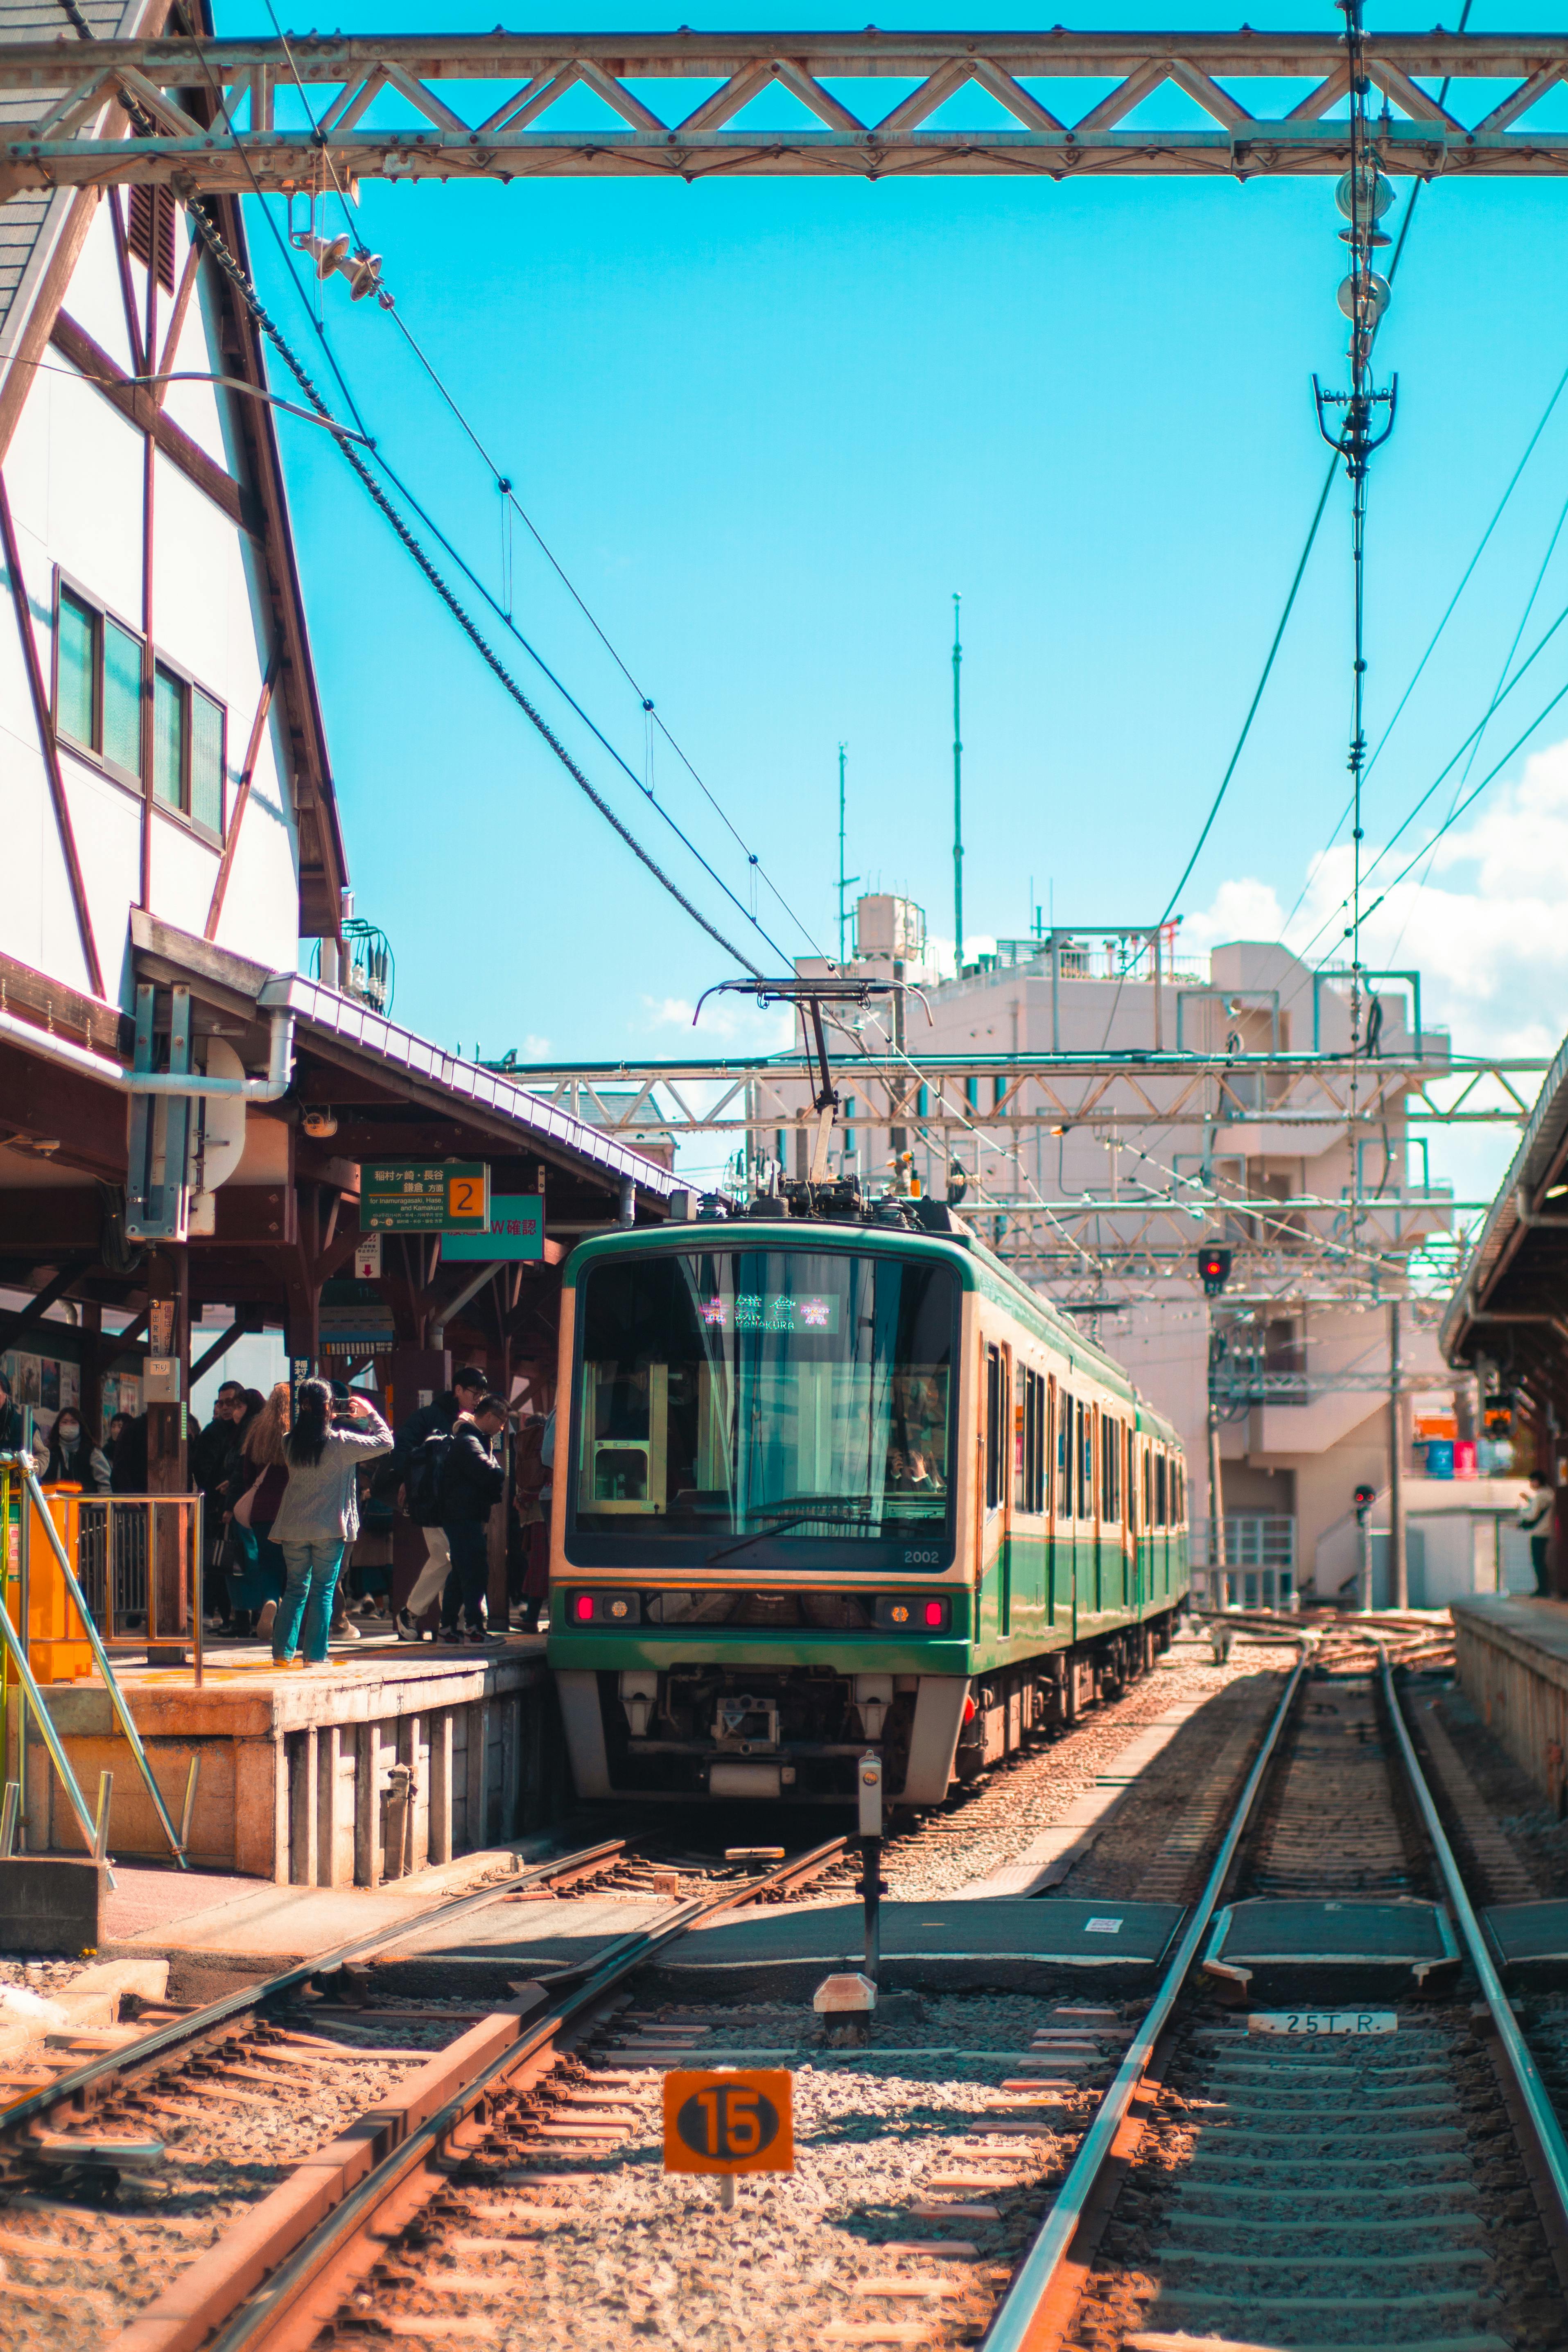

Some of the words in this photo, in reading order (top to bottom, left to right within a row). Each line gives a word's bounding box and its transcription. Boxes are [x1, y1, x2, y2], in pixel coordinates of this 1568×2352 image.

[403, 1182, 423, 1193] 鎌倉
[428, 1184, 444, 1193] 方面
[457, 1183, 473, 1211] 2
[153, 1364, 167, 1372] 下り
[905, 1551, 939, 1563] 2002
[697, 2089, 761, 2155] 15
